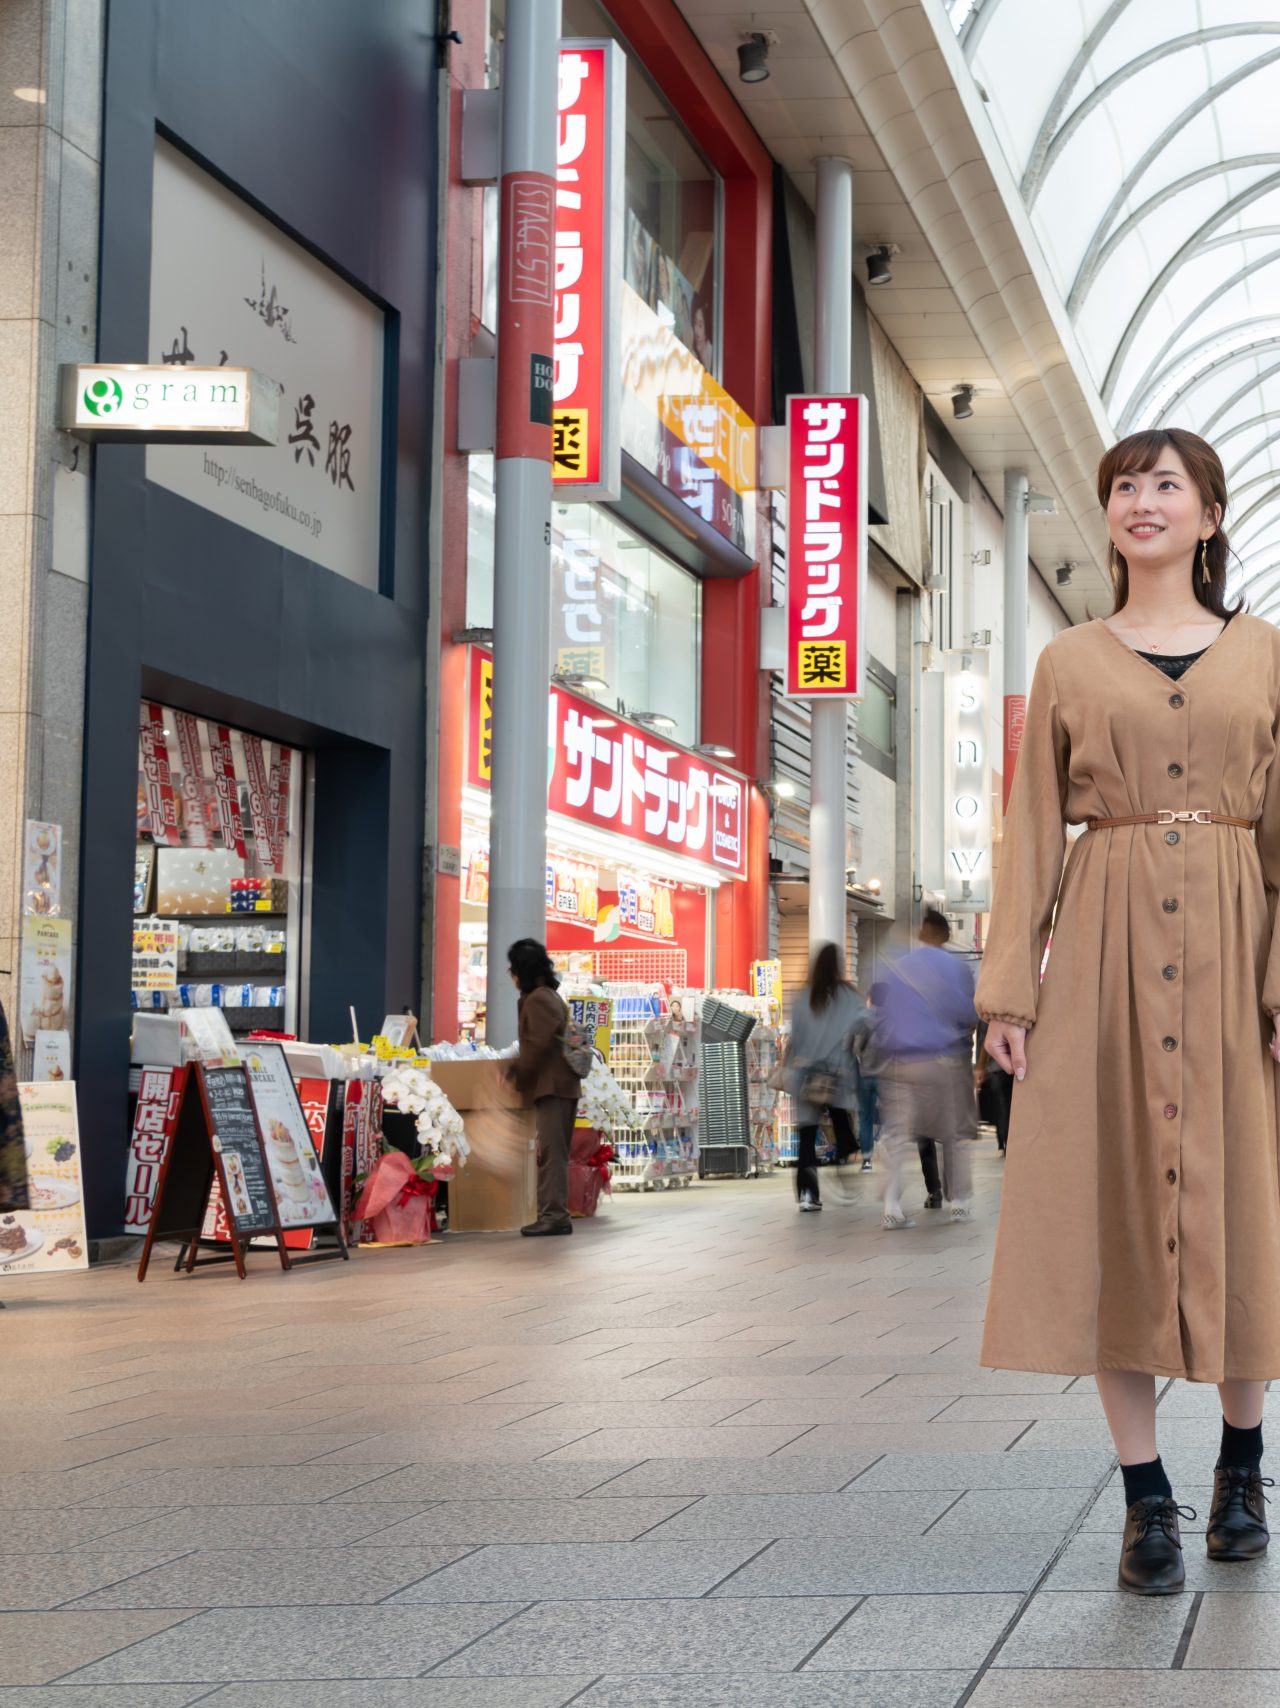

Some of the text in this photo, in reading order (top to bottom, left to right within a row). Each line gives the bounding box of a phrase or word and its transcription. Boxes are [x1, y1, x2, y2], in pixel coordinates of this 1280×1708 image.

[132, 381, 239, 410] gram
[801, 402, 847, 638] サンドラッグ
[803, 645, 842, 684] 薬
[563, 708, 710, 850] サンドラッグ
[597, 1000, 609, 1026] 本日
[250, 1073, 276, 1083] ANCAKE
[125, 1070, 174, 1225] 開店セール
